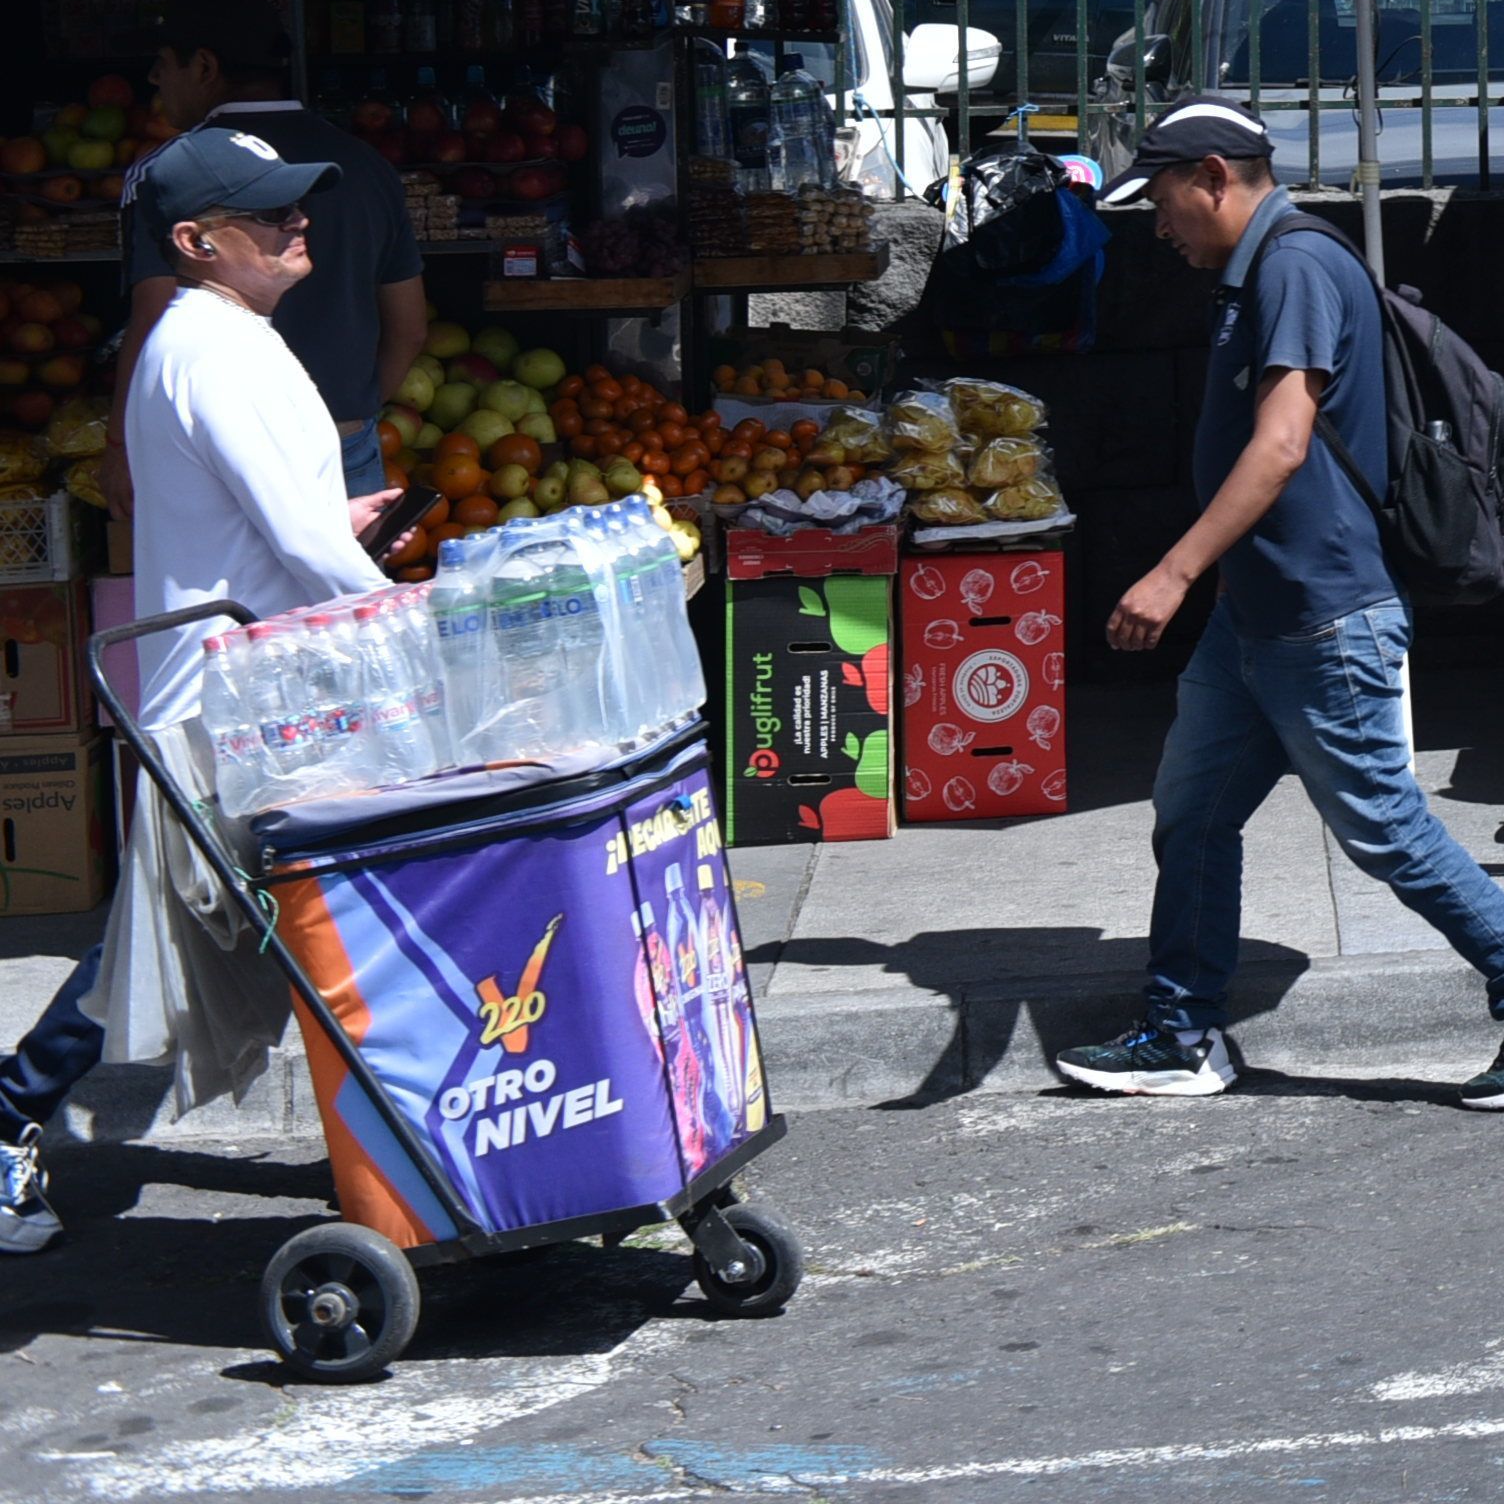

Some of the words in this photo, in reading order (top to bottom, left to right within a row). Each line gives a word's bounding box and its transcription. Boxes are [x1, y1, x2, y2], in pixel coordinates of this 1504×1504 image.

[1052, 33, 1090, 42] VITAA
[794, 685, 802, 696] es
[819, 669, 829, 720] MANZANAS
[793, 697, 803, 730] calidad
[802, 720, 812, 754] nuestra
[819, 725, 829, 759] APPLES
[2, 792, 77, 813] Apples
[479, 990, 546, 1045] 220
[439, 1059, 557, 1120] OTRO
[474, 1078, 625, 1158] NIVEL
